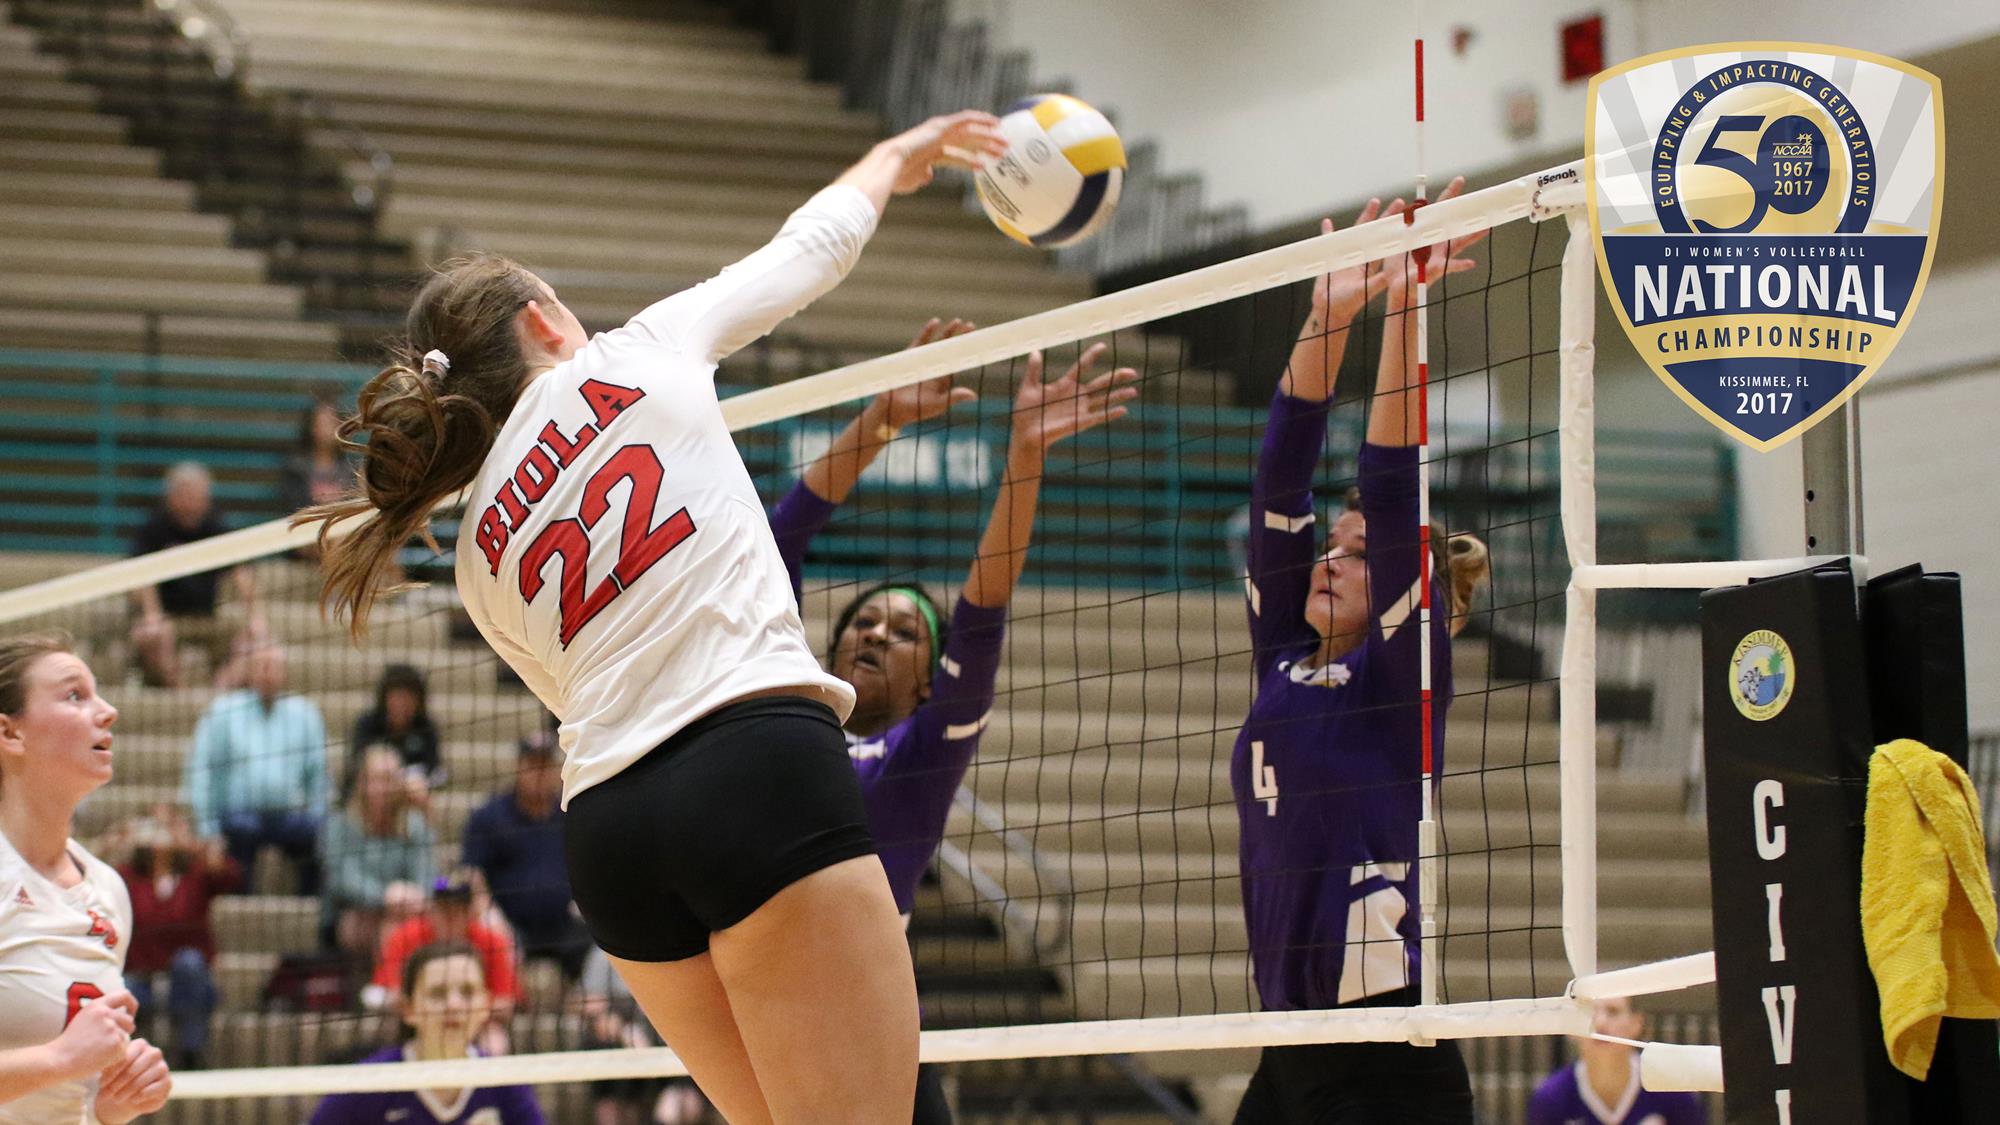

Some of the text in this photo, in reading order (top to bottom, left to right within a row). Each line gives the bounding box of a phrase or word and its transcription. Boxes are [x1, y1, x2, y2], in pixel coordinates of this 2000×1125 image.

[475, 377, 647, 583] BIOLA
[517, 443, 698, 652] 22
[1250, 740, 1279, 817] 4
